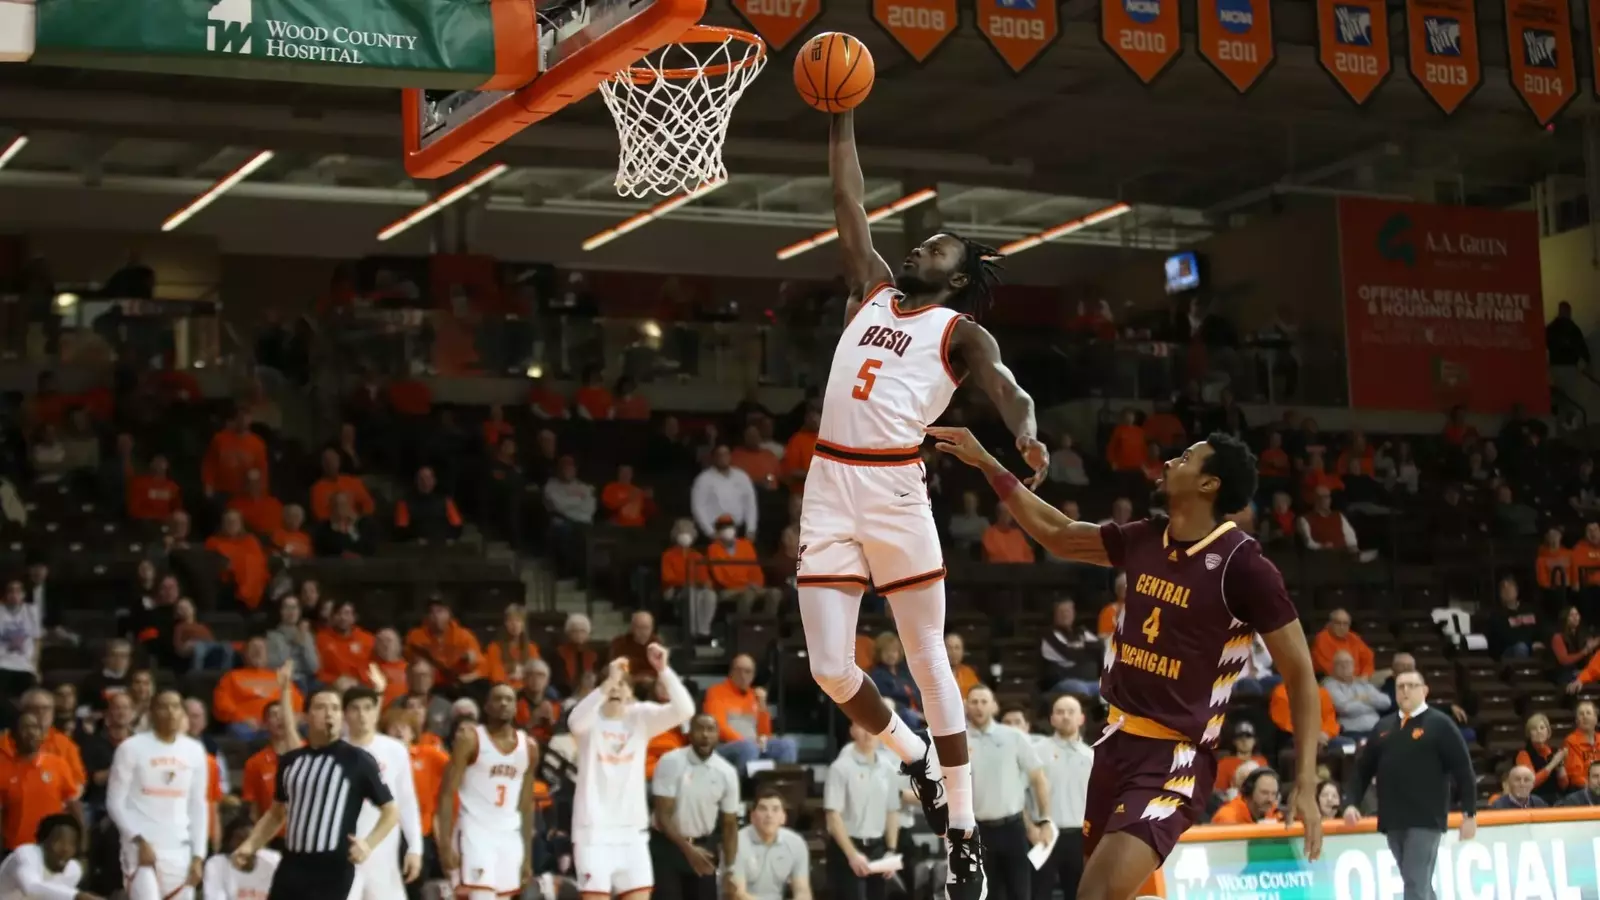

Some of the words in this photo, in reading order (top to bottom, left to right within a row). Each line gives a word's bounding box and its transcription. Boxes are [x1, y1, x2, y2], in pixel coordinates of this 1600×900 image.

[747, 0, 807, 18] 2007
[887, 5, 945, 31] 2008
[267, 20, 328, 42] WOOD
[333, 26, 418, 50] COUNTY
[989, 16, 1045, 40] 2009
[267, 39, 364, 64] HOSPITAL
[1119, 29, 1166, 53] 2010
[1217, 39, 1257, 62] 2011
[1335, 51, 1378, 76] 2012
[1425, 62, 1468, 85] 2013
[1524, 73, 1562, 96] 2014
[1459, 233, 1508, 257] GREEN
[1357, 285, 1430, 303] OFFICIAL
[1433, 289, 1475, 306] REAL
[1476, 292, 1532, 310] ESTATE
[1381, 302, 1452, 319] HOUSING
[1456, 305, 1525, 323] PARTNER
[858, 326, 913, 358] BGSU
[851, 358, 883, 401] 5
[1135, 573, 1191, 609] CENTRAL
[1142, 606, 1161, 644] 4
[494, 784, 506, 807] 3
[1216, 873, 1258, 891] WOOD
[1259, 871, 1314, 889] COUNTY
[1334, 838, 1582, 900] OFICIAL
